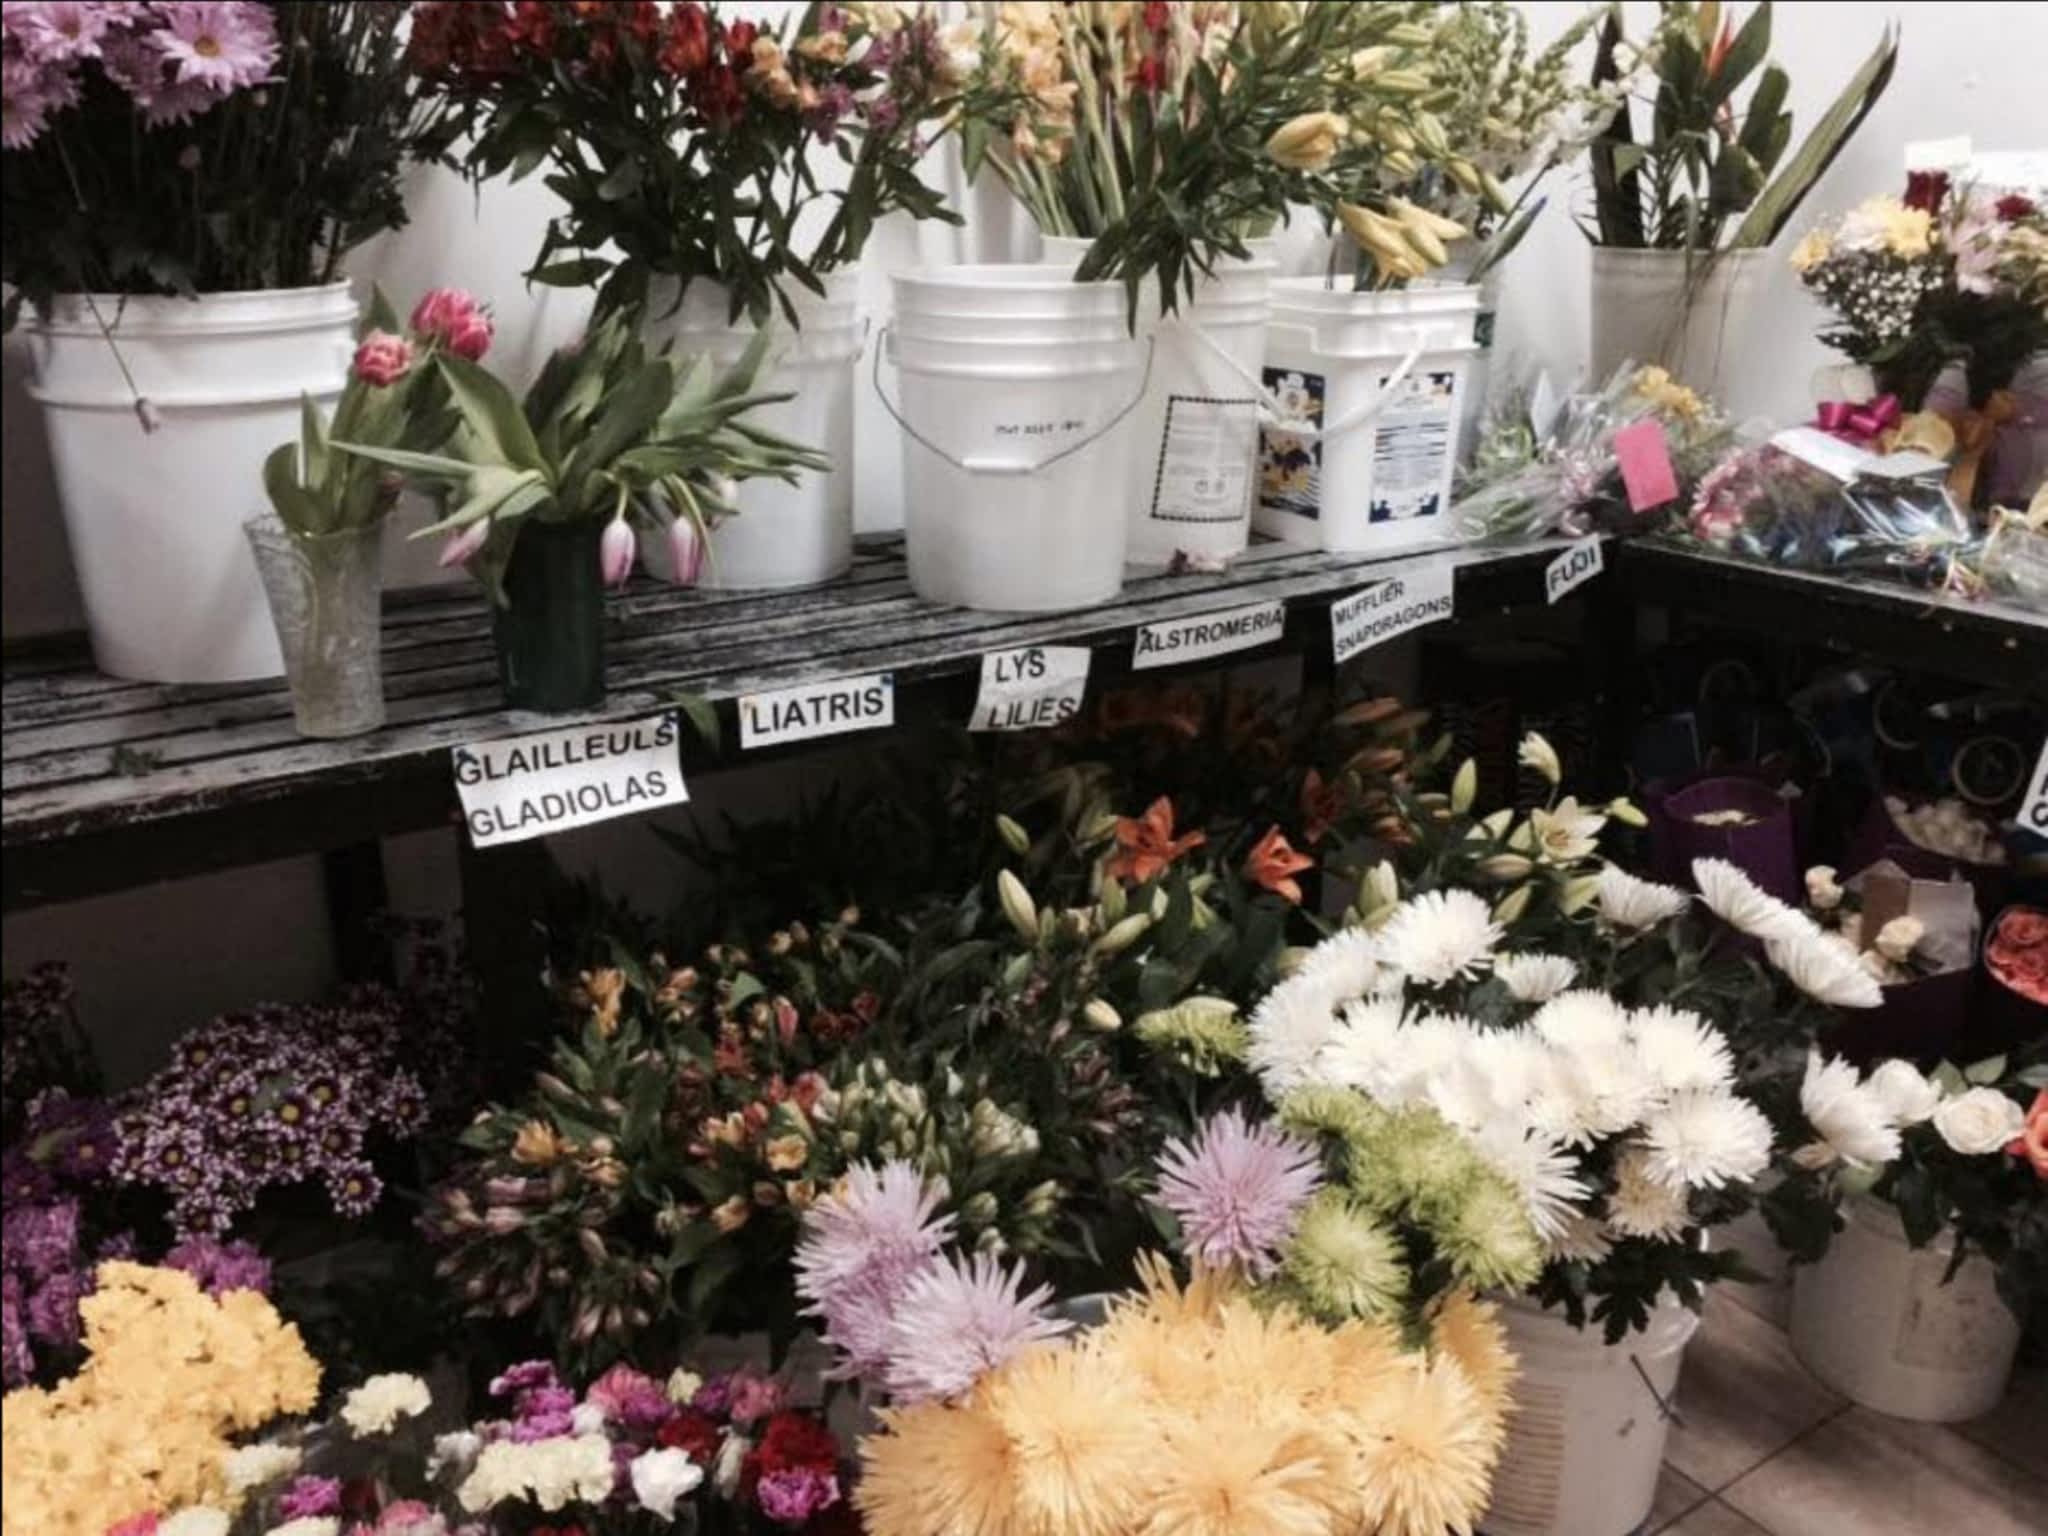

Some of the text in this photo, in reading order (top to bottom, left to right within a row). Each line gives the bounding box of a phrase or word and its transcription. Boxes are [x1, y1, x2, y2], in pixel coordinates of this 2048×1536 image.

[1549, 545, 1596, 592] FUJI
[1138, 608, 1283, 655] ALSTROMERIA
[1335, 595, 1452, 656] SNAPDRAGONS
[995, 648, 1046, 683] LYS
[750, 686, 885, 735] LIATRIS
[988, 697, 1077, 728] LILIES
[456, 722, 675, 786] GLAILLEULS
[469, 770, 668, 837] GLADIOLAS
